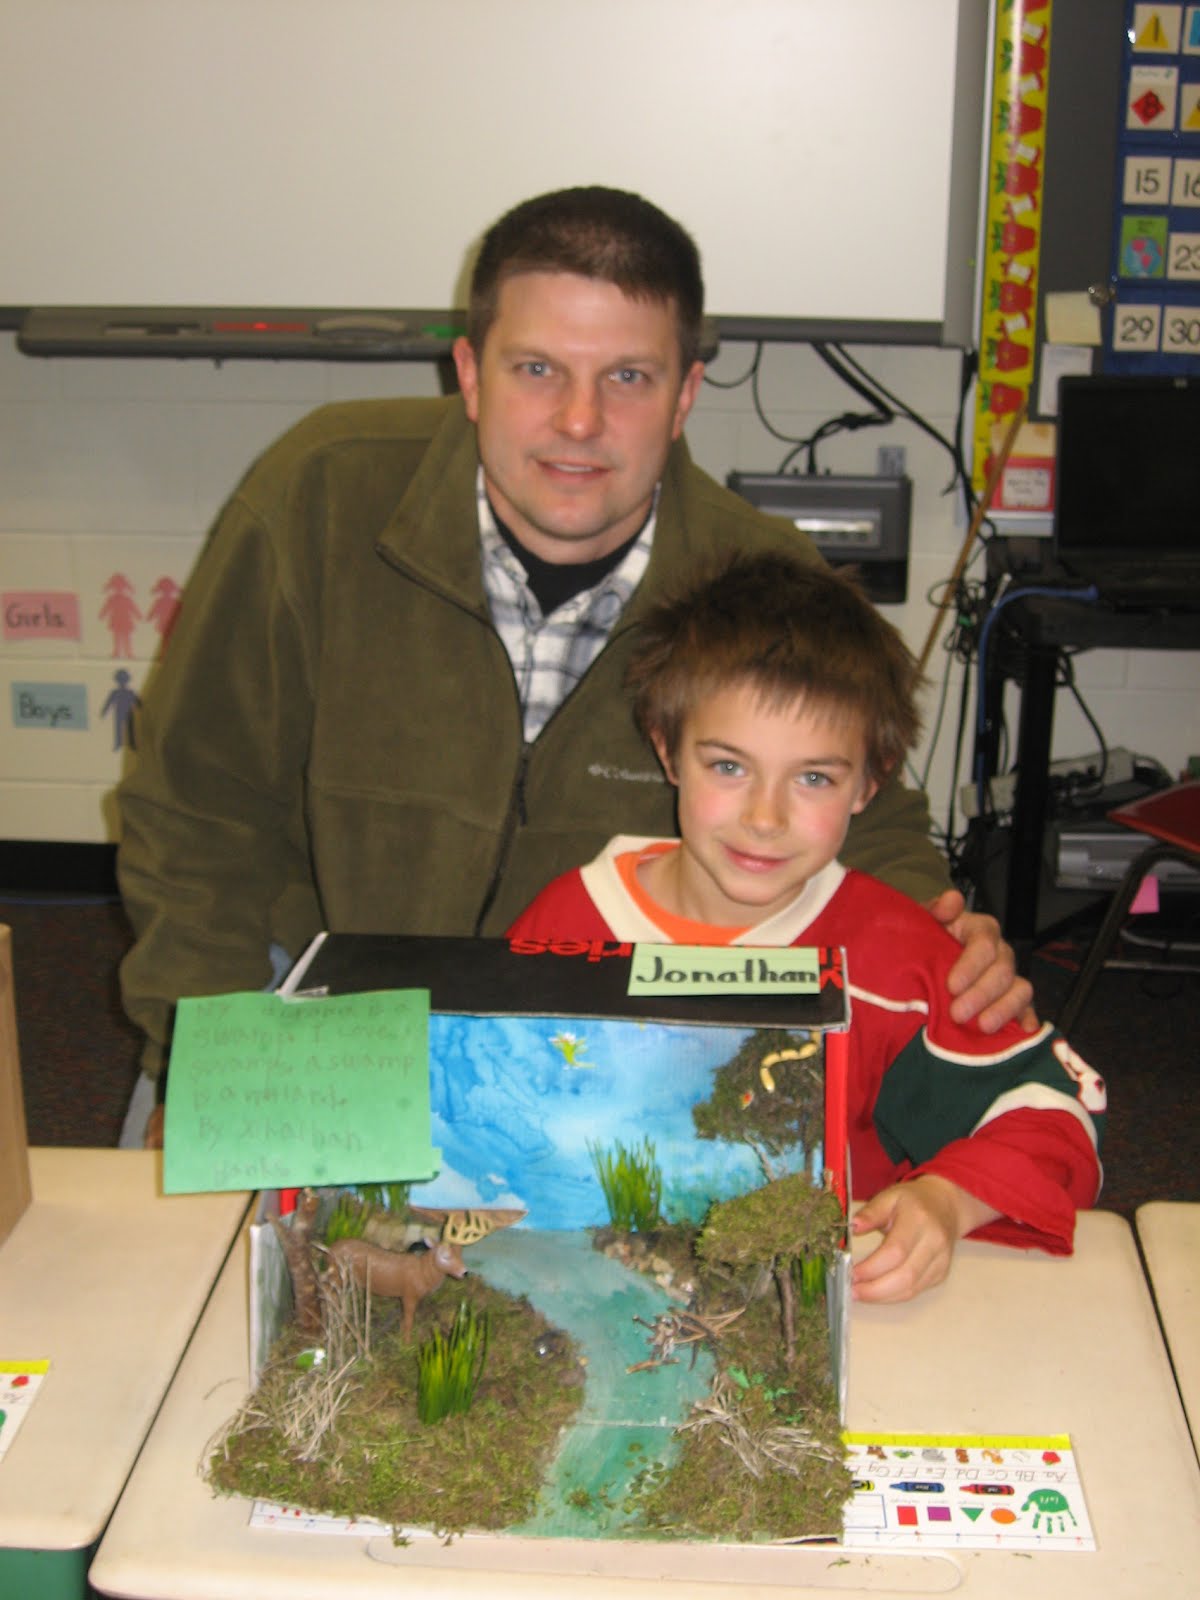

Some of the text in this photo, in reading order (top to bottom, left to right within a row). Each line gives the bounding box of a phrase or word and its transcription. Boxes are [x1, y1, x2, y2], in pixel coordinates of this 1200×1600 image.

[1135, 168, 1160, 195] 15
[1120, 315, 1200, 346] 29 30
[5, 601, 66, 629] Girls
[18, 691, 73, 728] Boys
[635, 956, 818, 985] Jonathan
